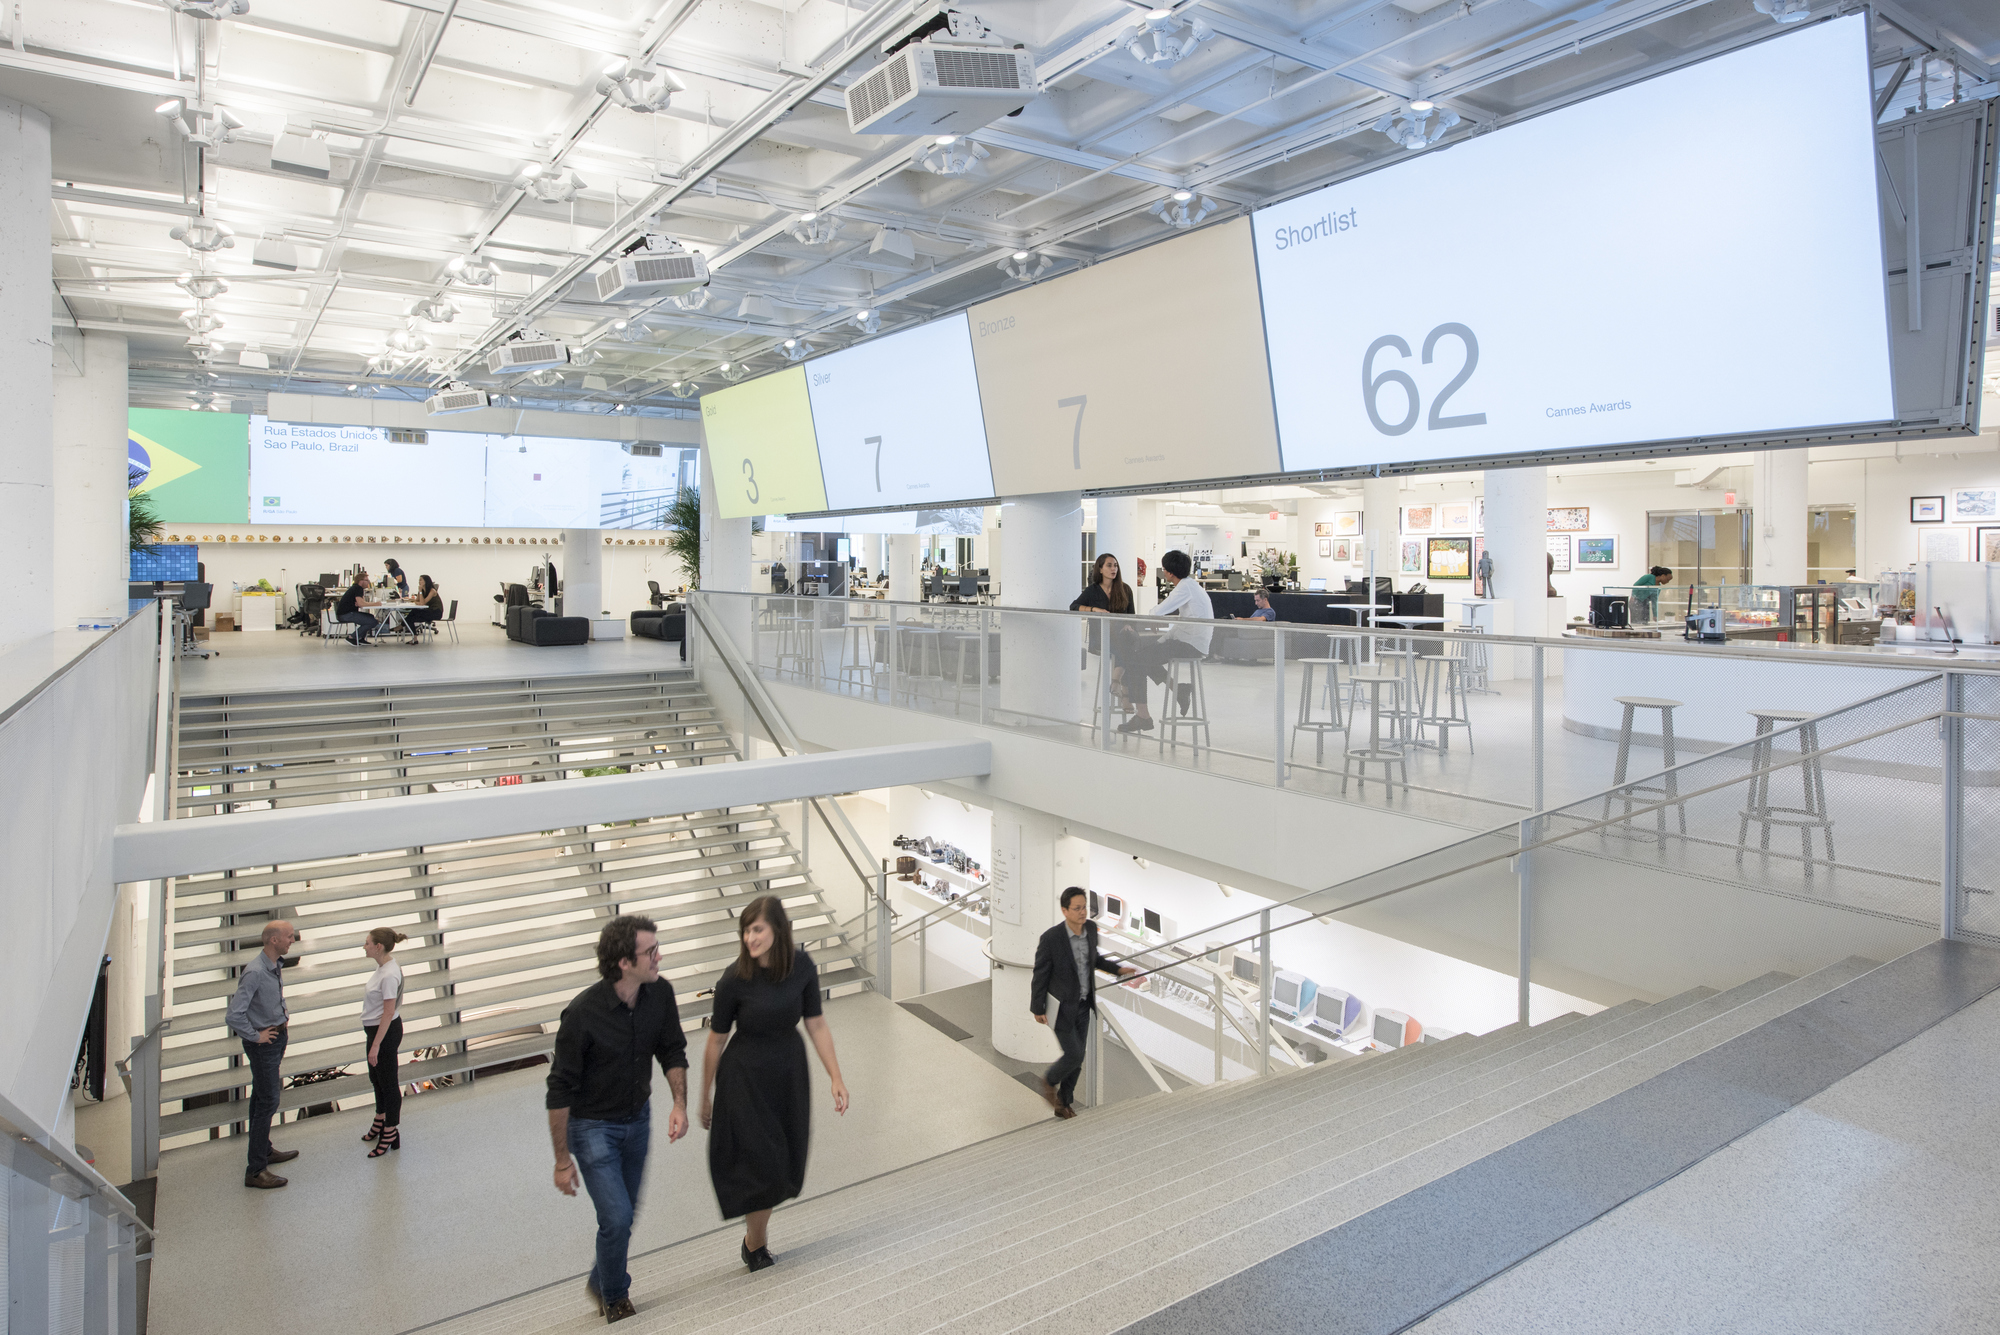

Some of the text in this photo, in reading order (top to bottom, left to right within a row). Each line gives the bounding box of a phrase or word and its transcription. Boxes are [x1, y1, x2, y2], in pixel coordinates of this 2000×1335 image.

[1275, 207, 1358, 250] Shortlist
[979, 315, 1016, 337] Bronze
[813, 373, 831, 387] Silver
[1361, 322, 1488, 437] 62
[706, 404, 717, 417] Gold
[1545, 399, 1632, 418] Cannes Awards
[264, 426, 378, 440] Rua Estados Unidos
[1057, 394, 1087, 470] 7
[264, 439, 359, 452] Sao Paulo, Brazil
[864, 435, 882, 493] 7
[742, 458, 759, 505] 3
[499, 775, 520, 786] EXIT
